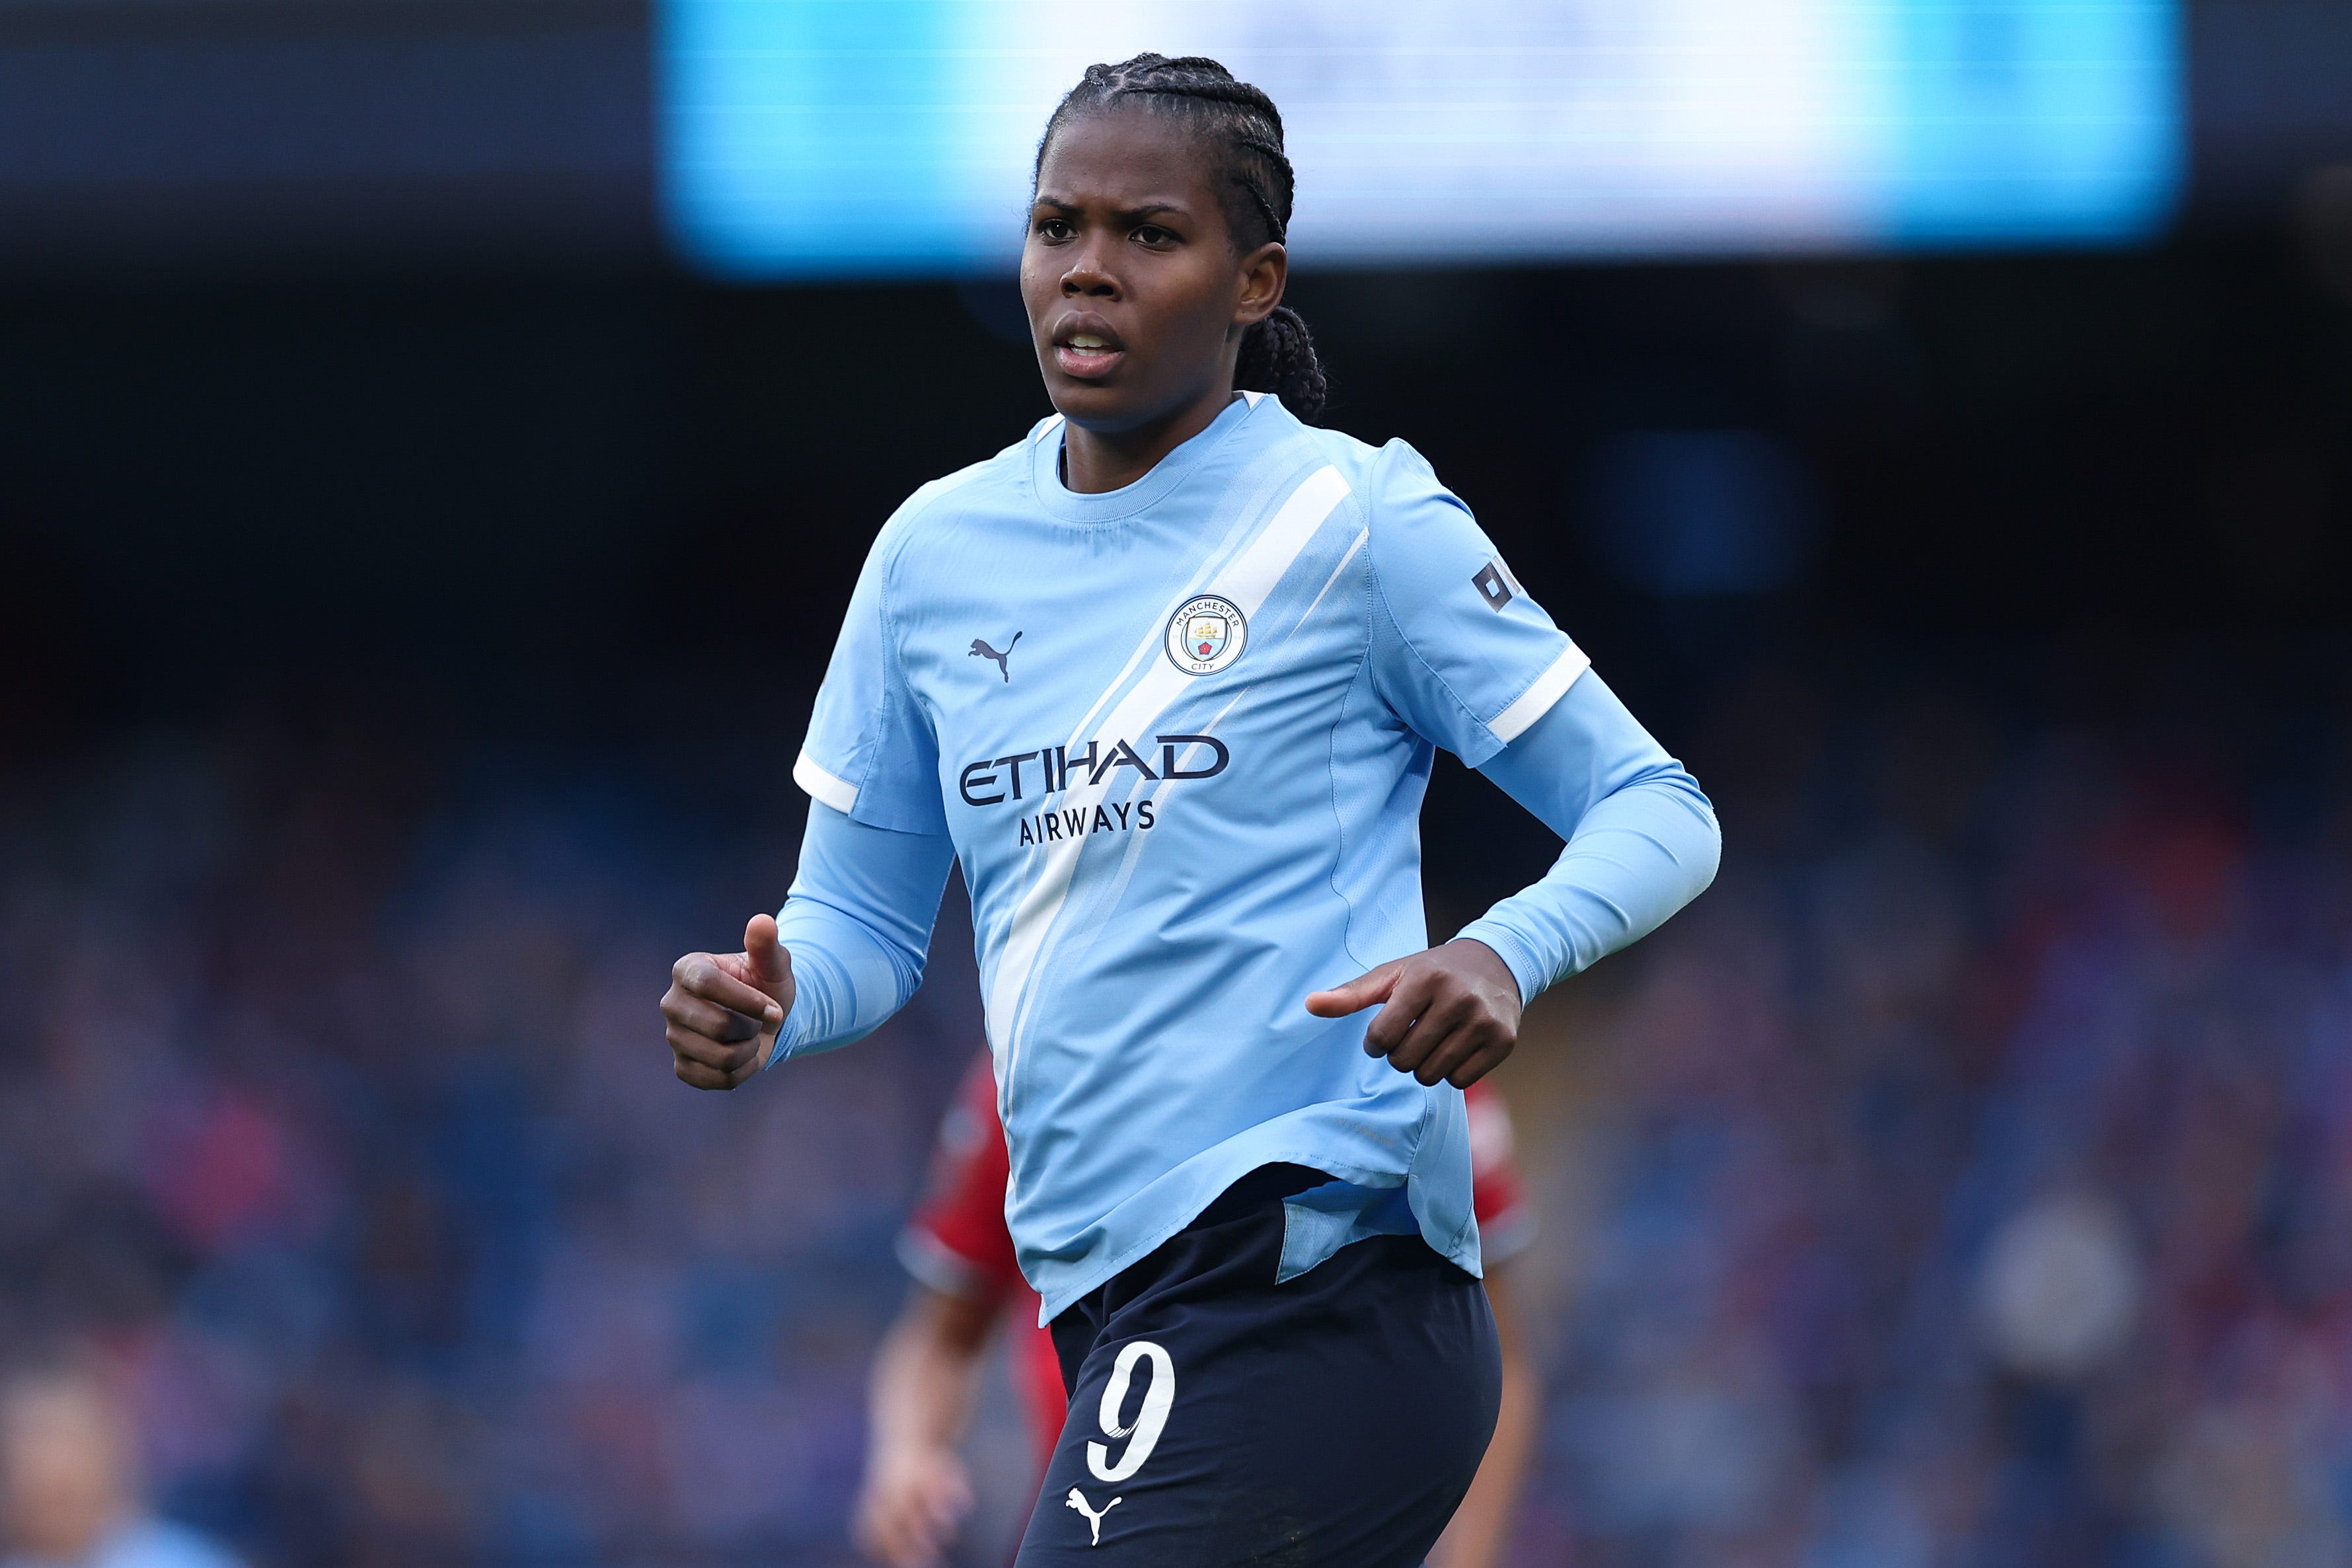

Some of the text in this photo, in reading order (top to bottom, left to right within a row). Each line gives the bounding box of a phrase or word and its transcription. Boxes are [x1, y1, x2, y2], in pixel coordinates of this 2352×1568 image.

[1176, 601, 1239, 626] MANCHESTER
[960, 735, 1230, 807] ETIHAD
[1020, 800, 1155, 846] AIRWAYS
[1086, 1341, 1175, 1482] 9
